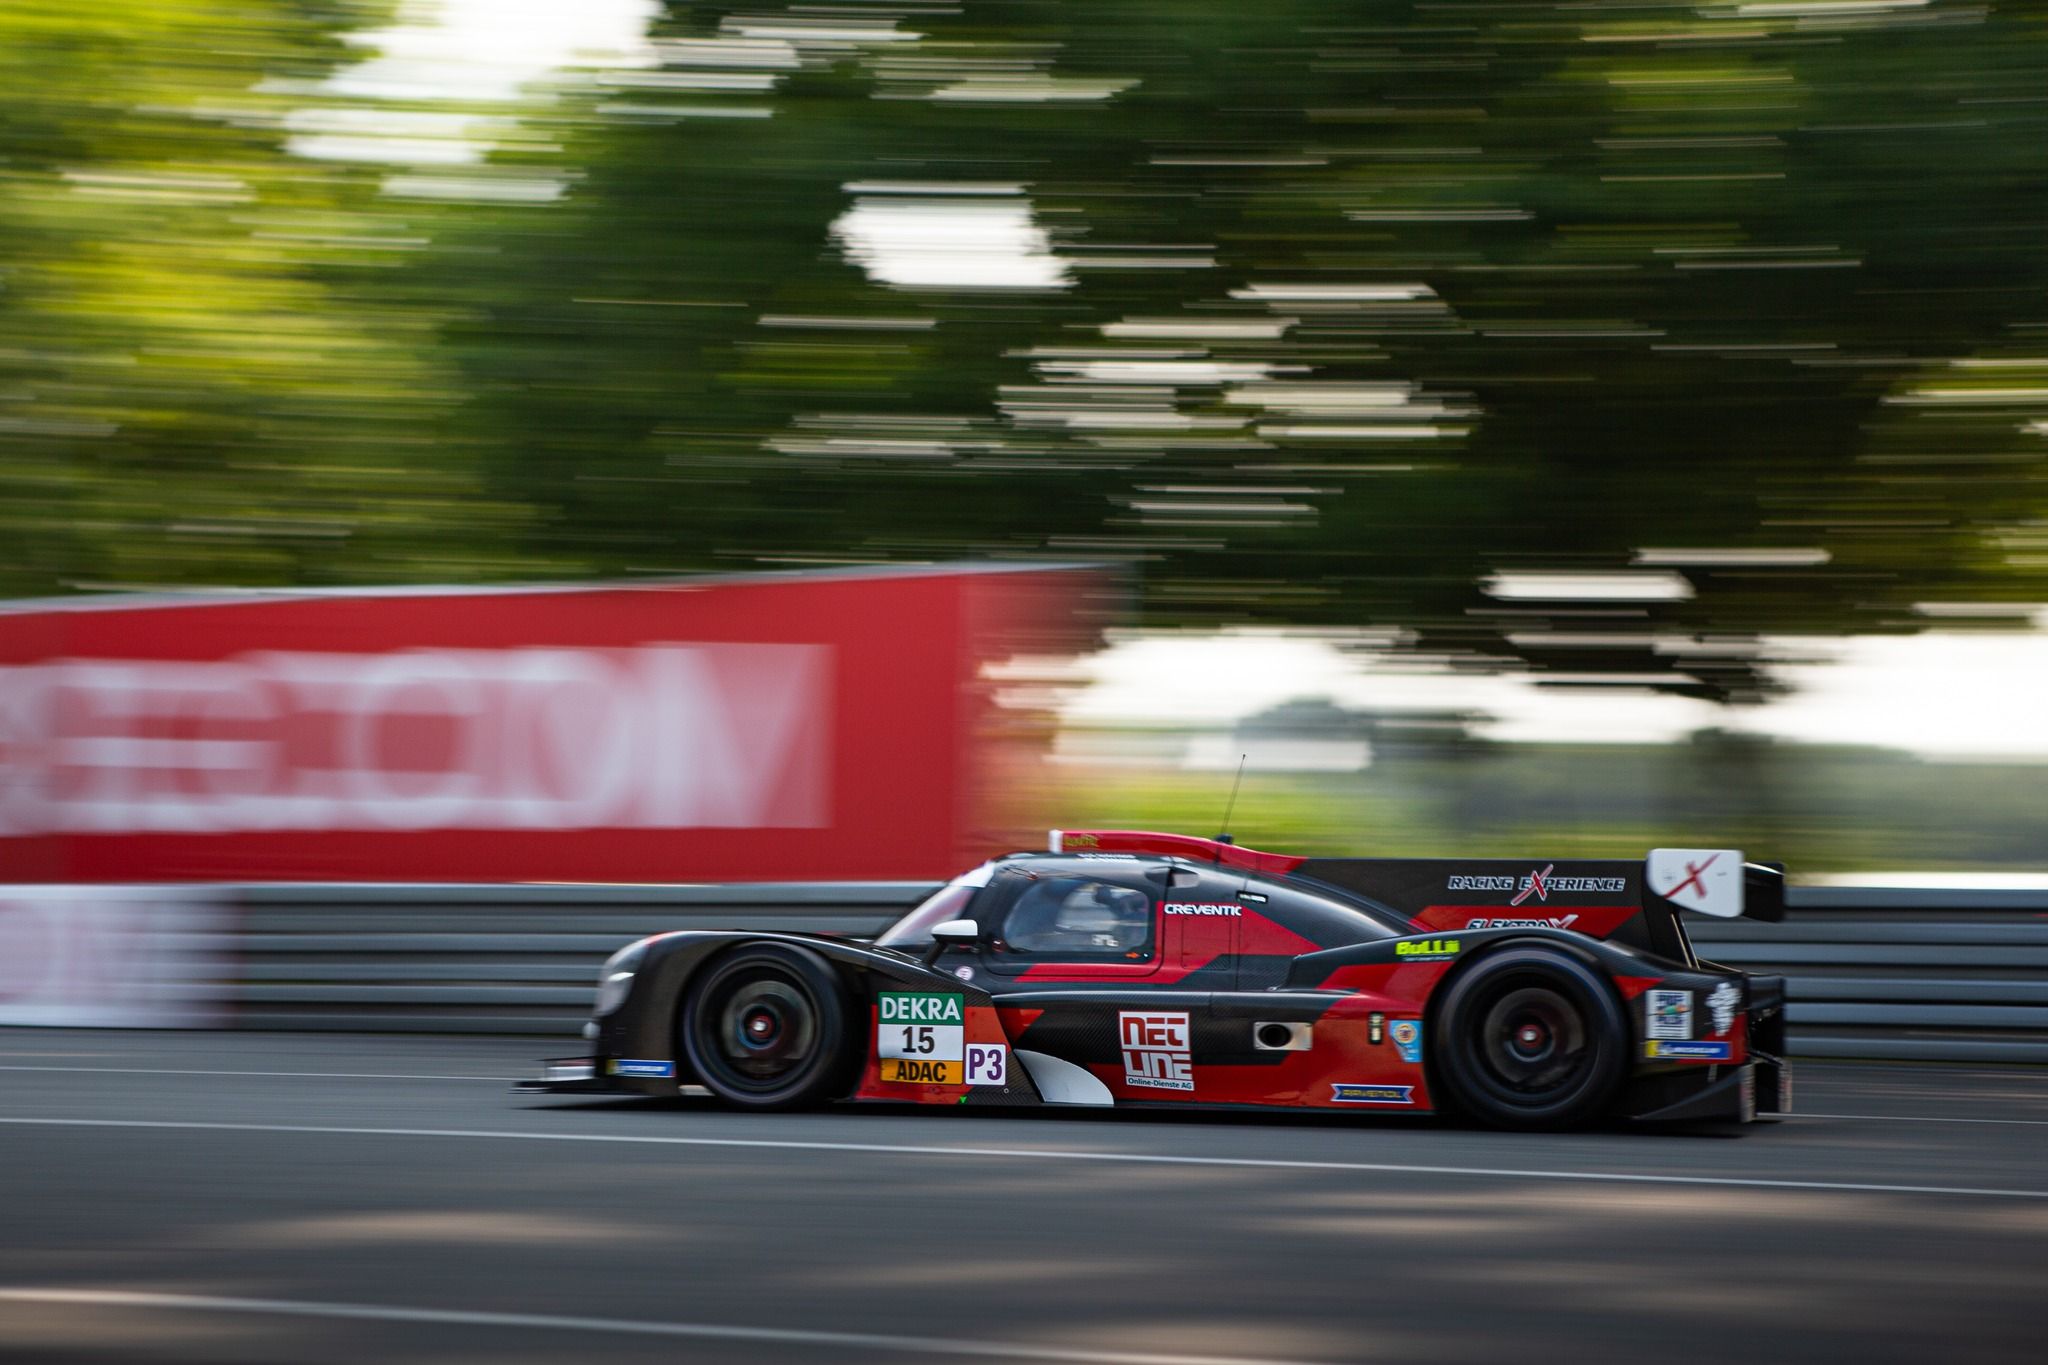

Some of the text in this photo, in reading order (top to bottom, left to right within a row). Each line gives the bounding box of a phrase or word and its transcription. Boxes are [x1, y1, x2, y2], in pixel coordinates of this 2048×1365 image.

[1448, 864, 1626, 906] RACING EXPERIENCE
[1164, 903, 1242, 916] CREVENTIC
[881, 997, 961, 1020] DEKRA
[902, 1026, 935, 1054] 15
[1122, 1017, 1185, 1047] NET
[896, 1061, 947, 1082] ADAC
[968, 1048, 1003, 1081] P3
[1122, 1051, 1192, 1080] LINE
[1128, 1077, 1180, 1088] Online-Dienste
